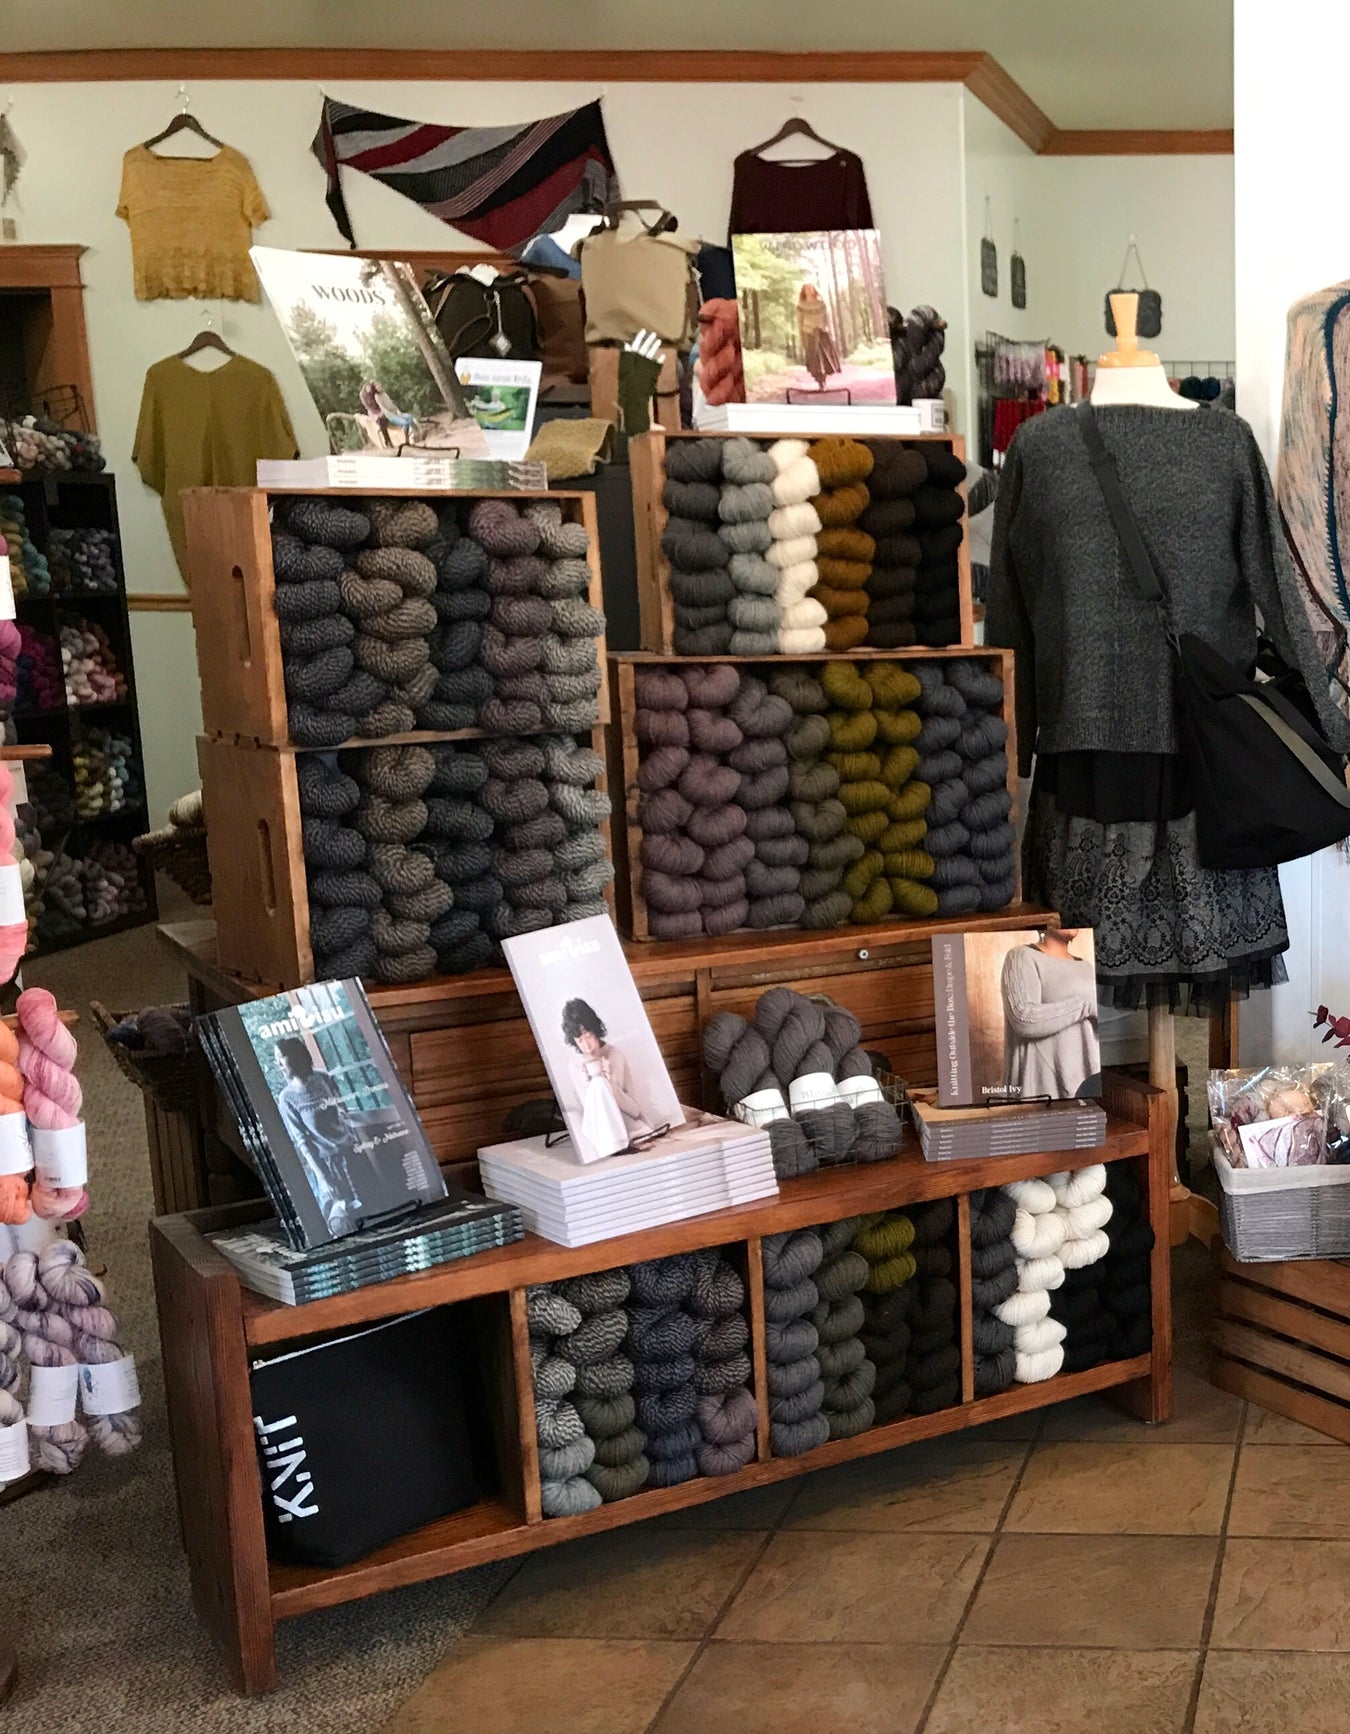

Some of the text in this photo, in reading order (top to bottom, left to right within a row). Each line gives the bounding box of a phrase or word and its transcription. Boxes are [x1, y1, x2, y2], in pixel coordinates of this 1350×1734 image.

[311, 284, 386, 305] WOODS
[947, 1012, 955, 1026] the
[948, 1028, 957, 1059] Outside
[950, 1060, 959, 1096] Knitting
[981, 1085, 1021, 1094] Bristol Ivy
[253, 1415, 320, 1523] KNIT
